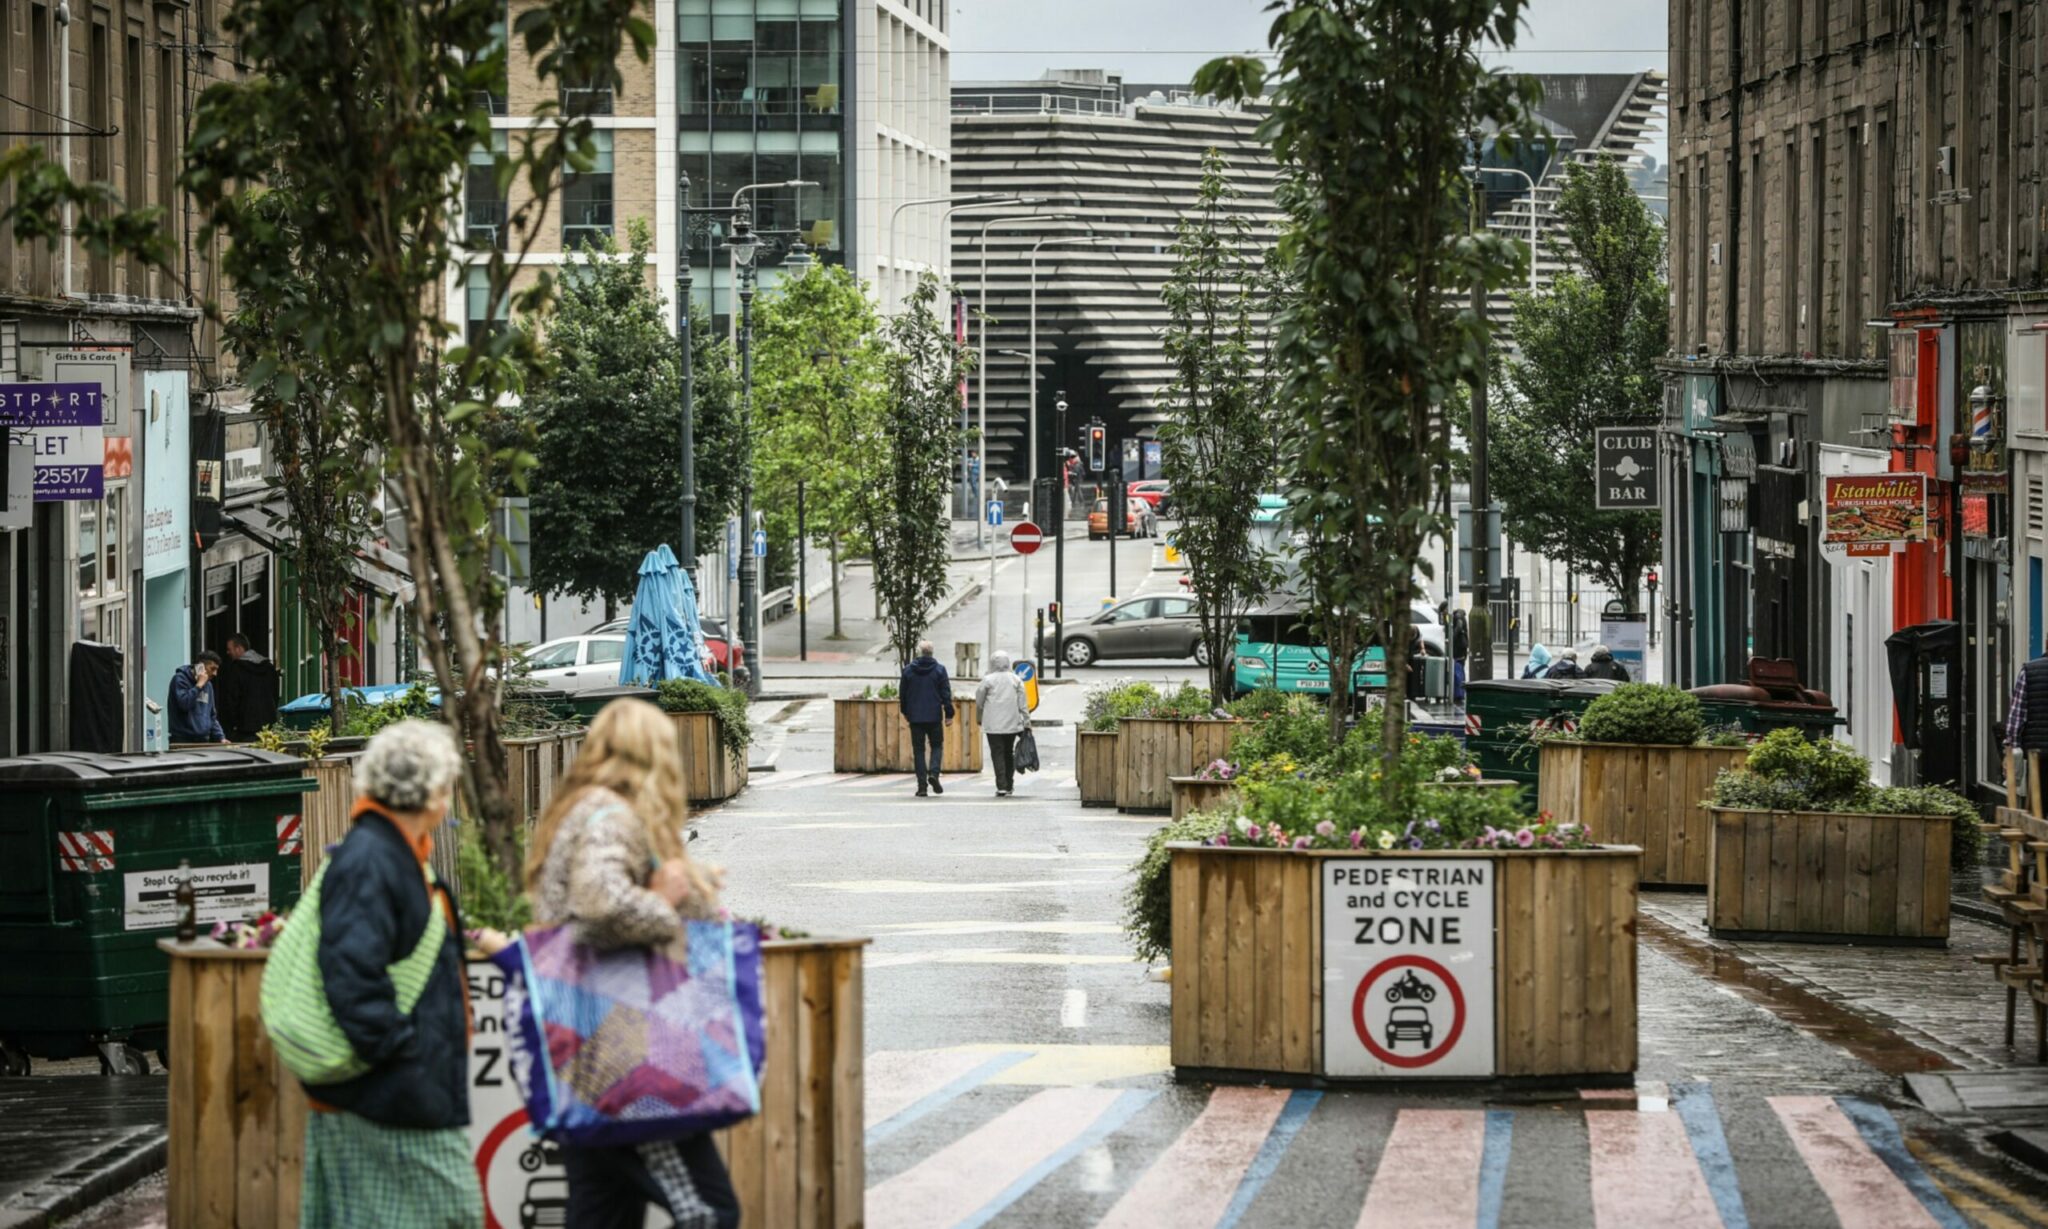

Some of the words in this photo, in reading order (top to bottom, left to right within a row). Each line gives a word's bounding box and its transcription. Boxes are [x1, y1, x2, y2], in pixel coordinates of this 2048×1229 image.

[56, 353, 78, 361] Gifts
[89, 353, 117, 361] Cards
[1603, 436, 1652, 450] CLUB
[1609, 486, 1648, 500] BAR
[1834, 481, 1917, 499] Istanbulie
[1852, 543, 1869, 552] JUST
[206, 870, 238, 883] recycle
[1333, 868, 1484, 886] PEDESTRIAN
[1346, 890, 1385, 909] and
[1394, 891, 1470, 909] CYCLE
[1355, 917, 1462, 946] ZONE
